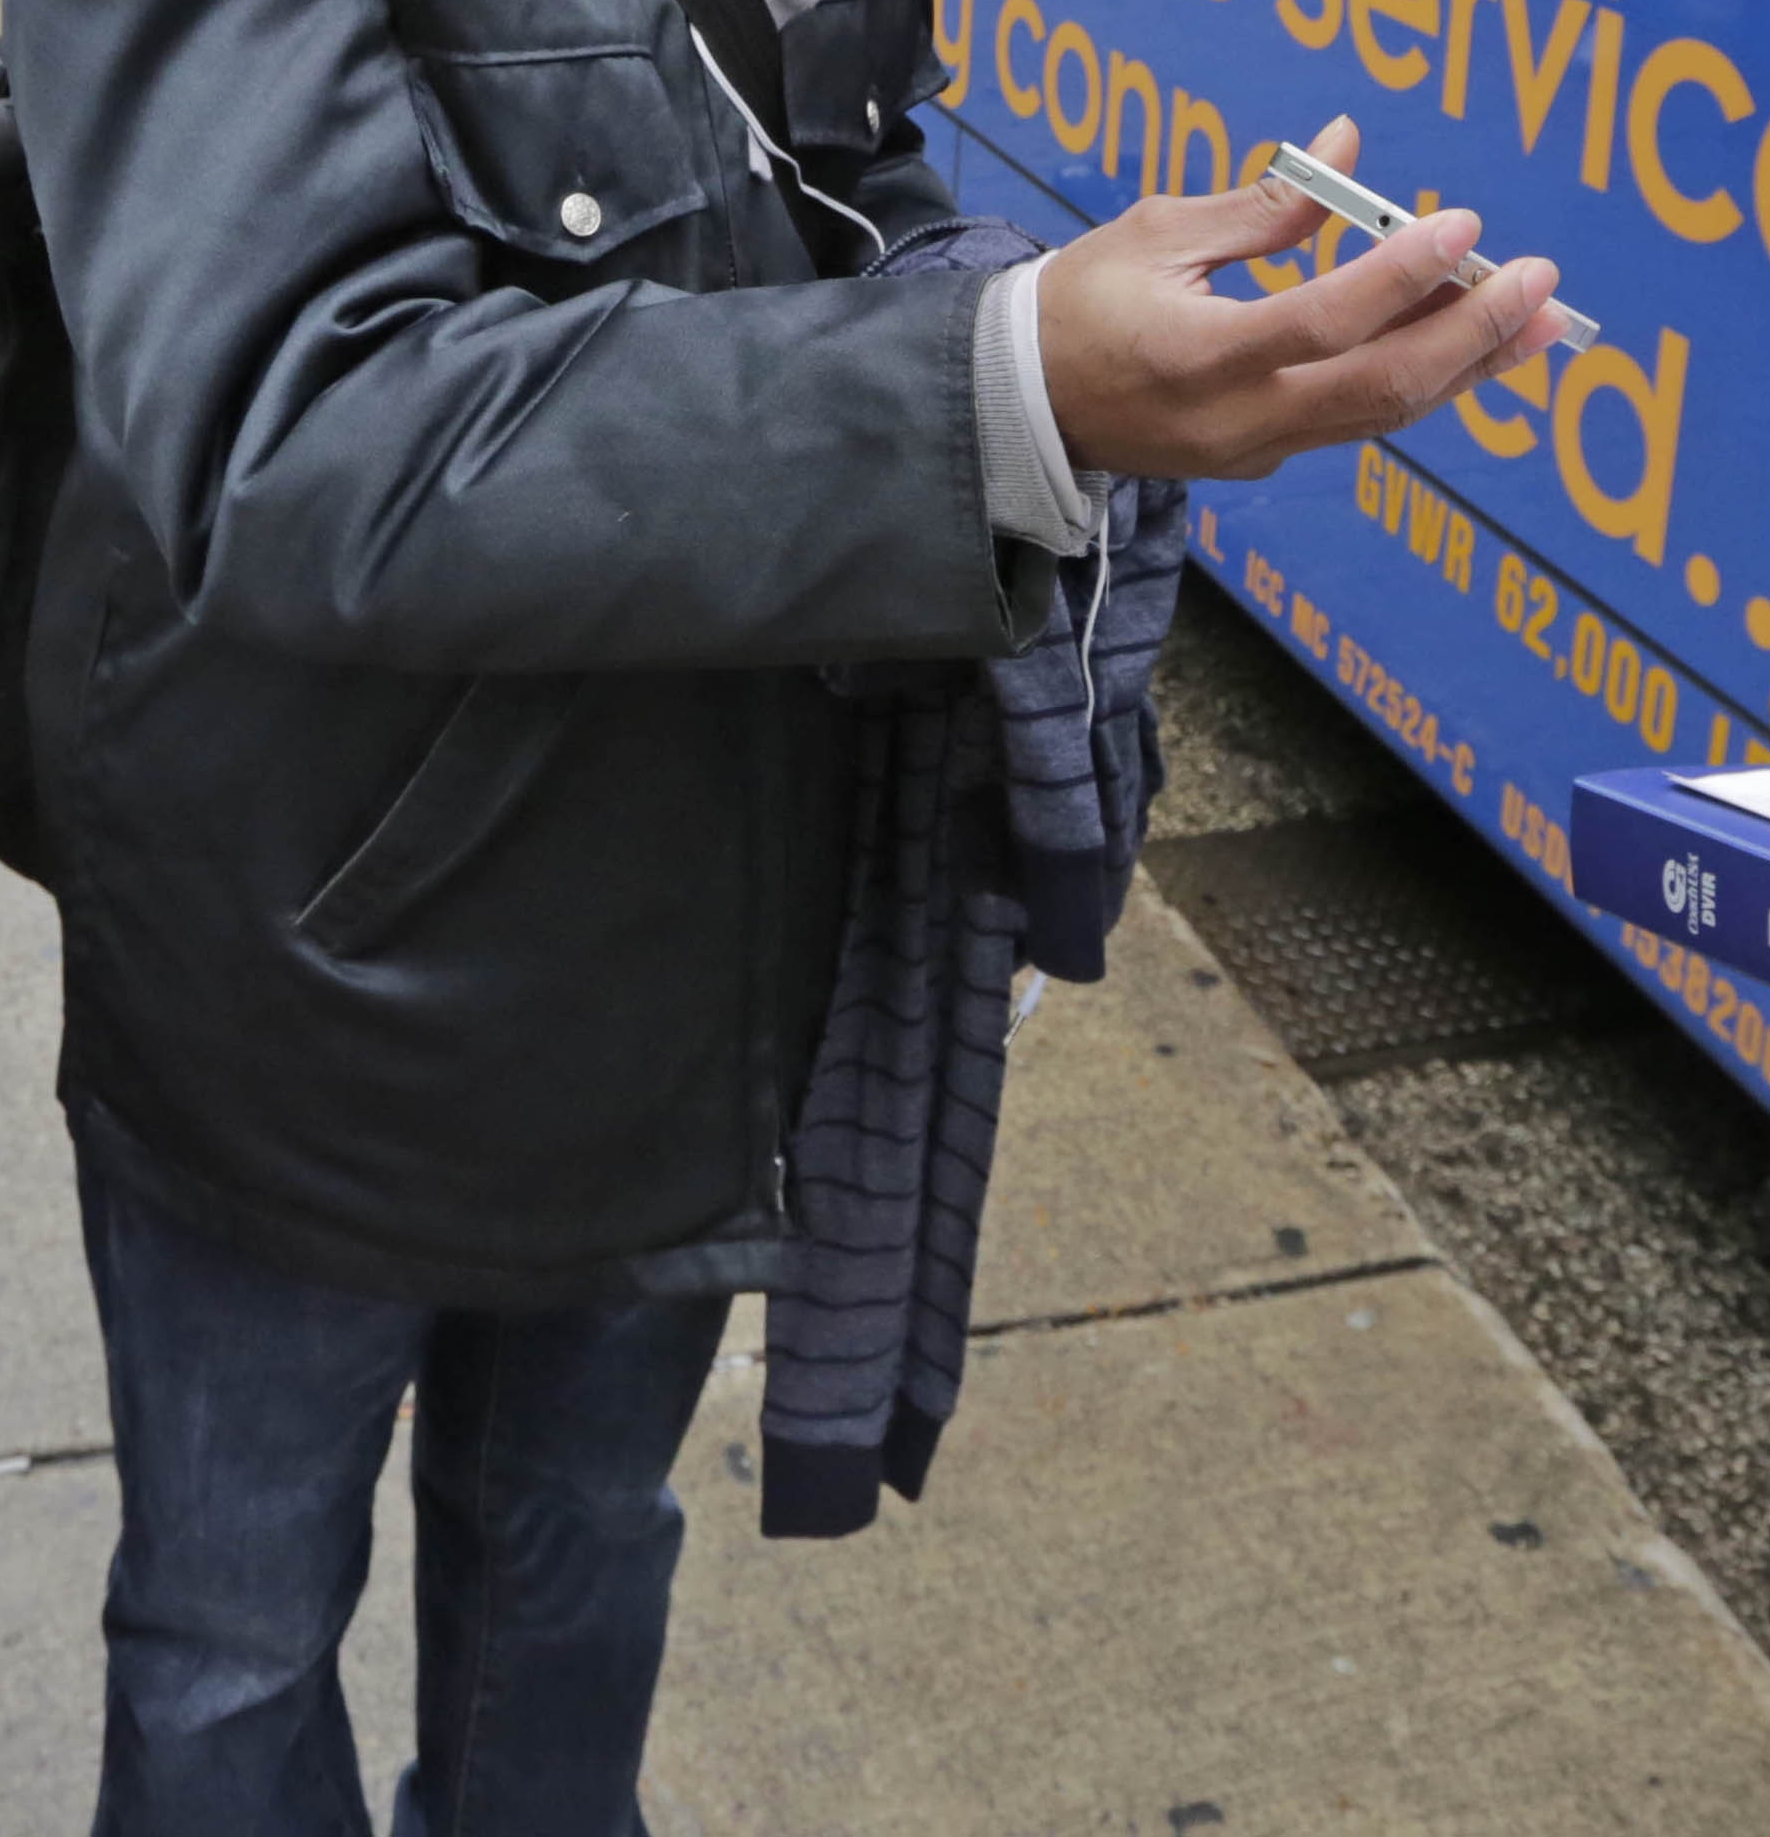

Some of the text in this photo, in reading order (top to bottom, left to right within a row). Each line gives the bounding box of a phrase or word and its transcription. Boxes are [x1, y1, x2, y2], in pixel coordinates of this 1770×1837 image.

[1244, 549, 1286, 618] ICC
[1291, 592, 1330, 660] MC
[1337, 634, 1476, 796] 572524-C
[1356, 442, 1476, 594] GVWR
[1495, 552, 1678, 754] 62,000
[1700, 871, 1717, 928] DVIR
